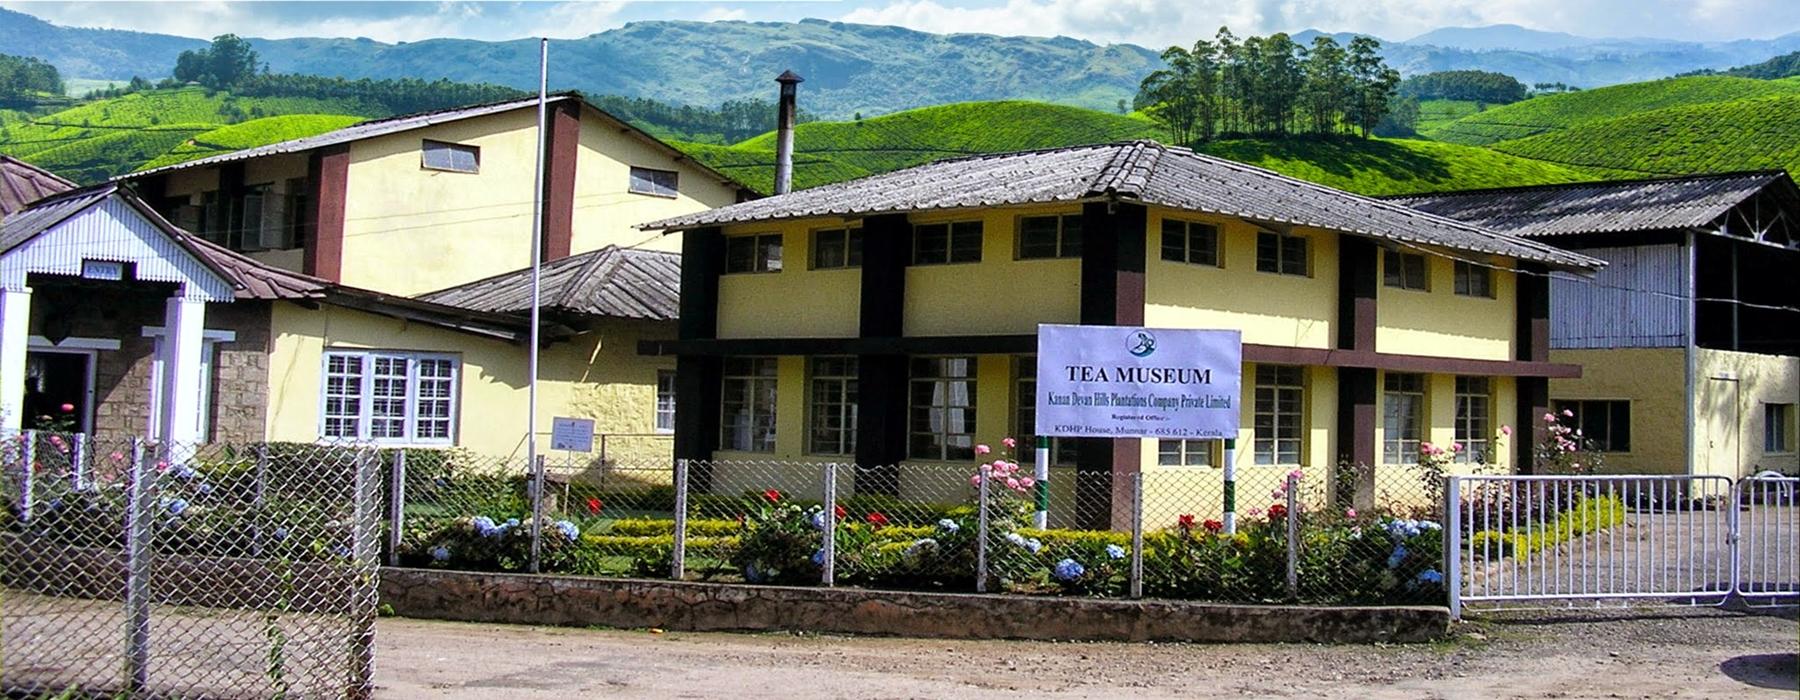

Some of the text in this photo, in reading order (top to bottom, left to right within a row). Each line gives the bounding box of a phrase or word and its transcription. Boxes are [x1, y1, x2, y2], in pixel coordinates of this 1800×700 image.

[1065, 366, 1211, 385] TEA MUSEUM
[1048, 392, 1231, 412] Kanan Devan Hills Plantations Company Private Limited
[1054, 425, 1083, 433] KDHP
[1085, 426, 1113, 434] House,
[1115, 427, 1147, 435] Munnar
[1172, 428, 1188, 436] 612
[1196, 429, 1223, 437] Kerala
